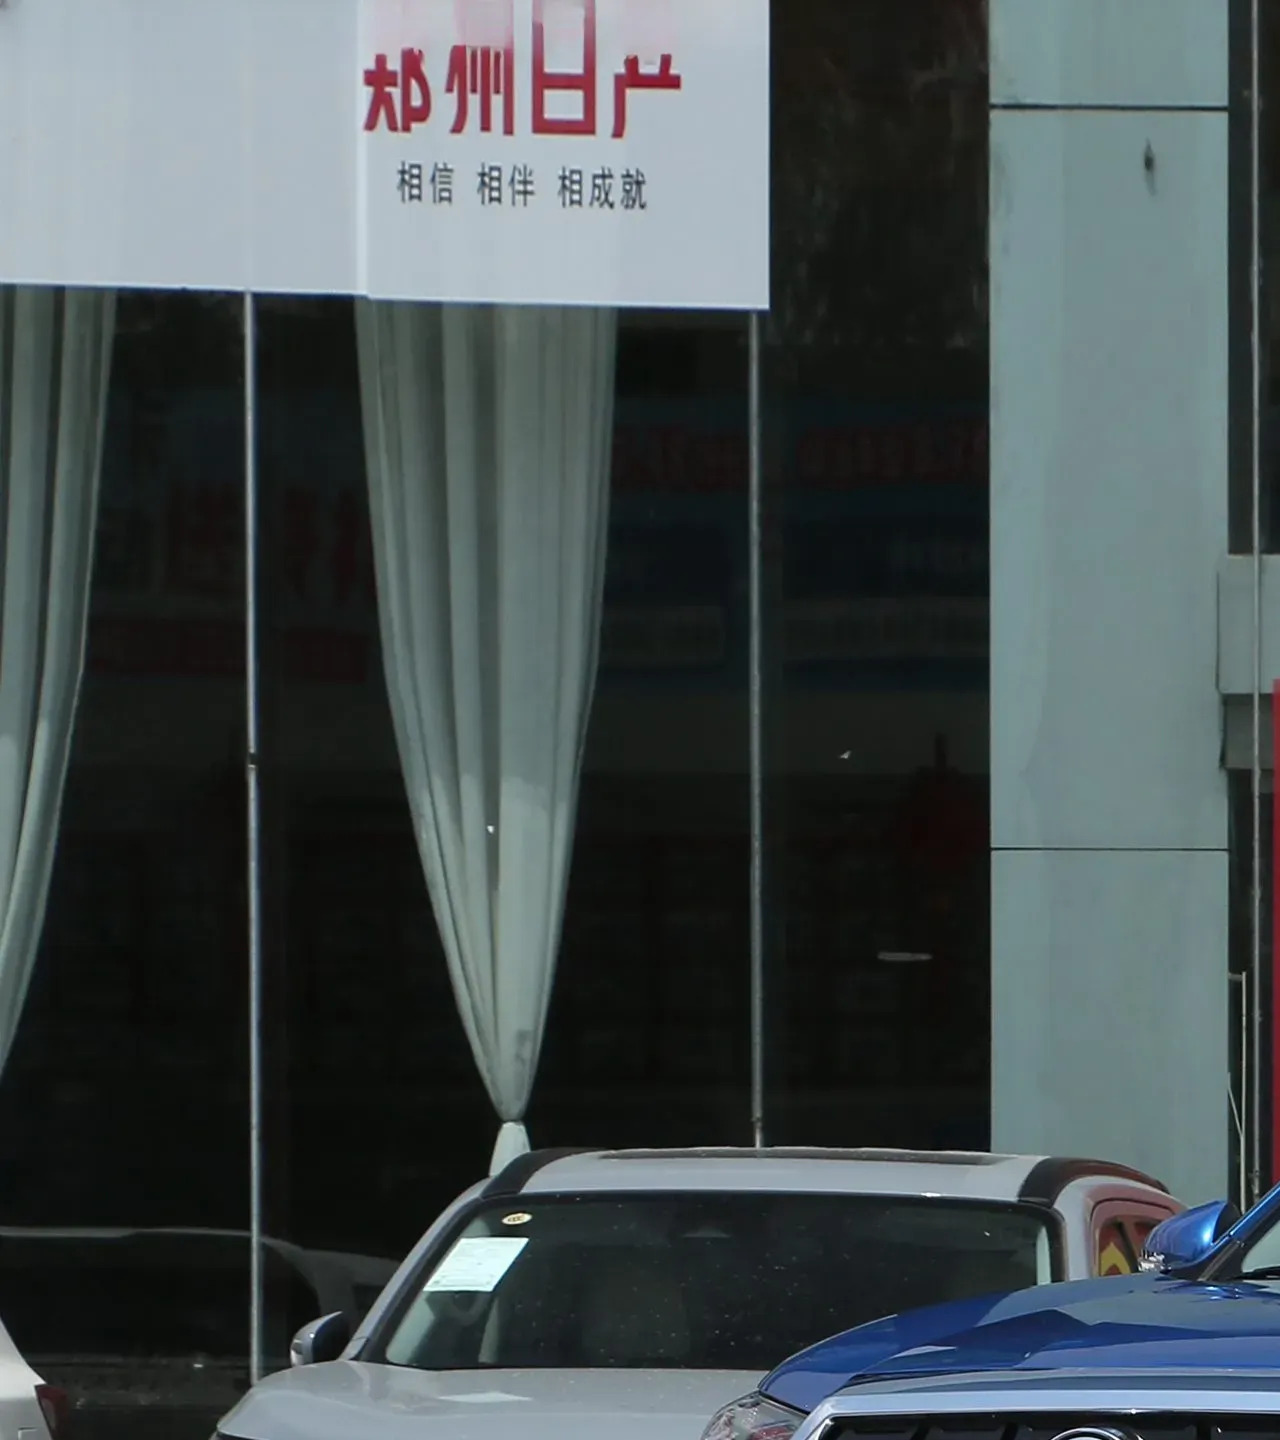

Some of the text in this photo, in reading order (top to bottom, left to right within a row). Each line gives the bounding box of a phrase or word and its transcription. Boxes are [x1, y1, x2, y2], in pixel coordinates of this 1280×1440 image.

[397, 162, 647, 210] 相信 相伴 相成就
